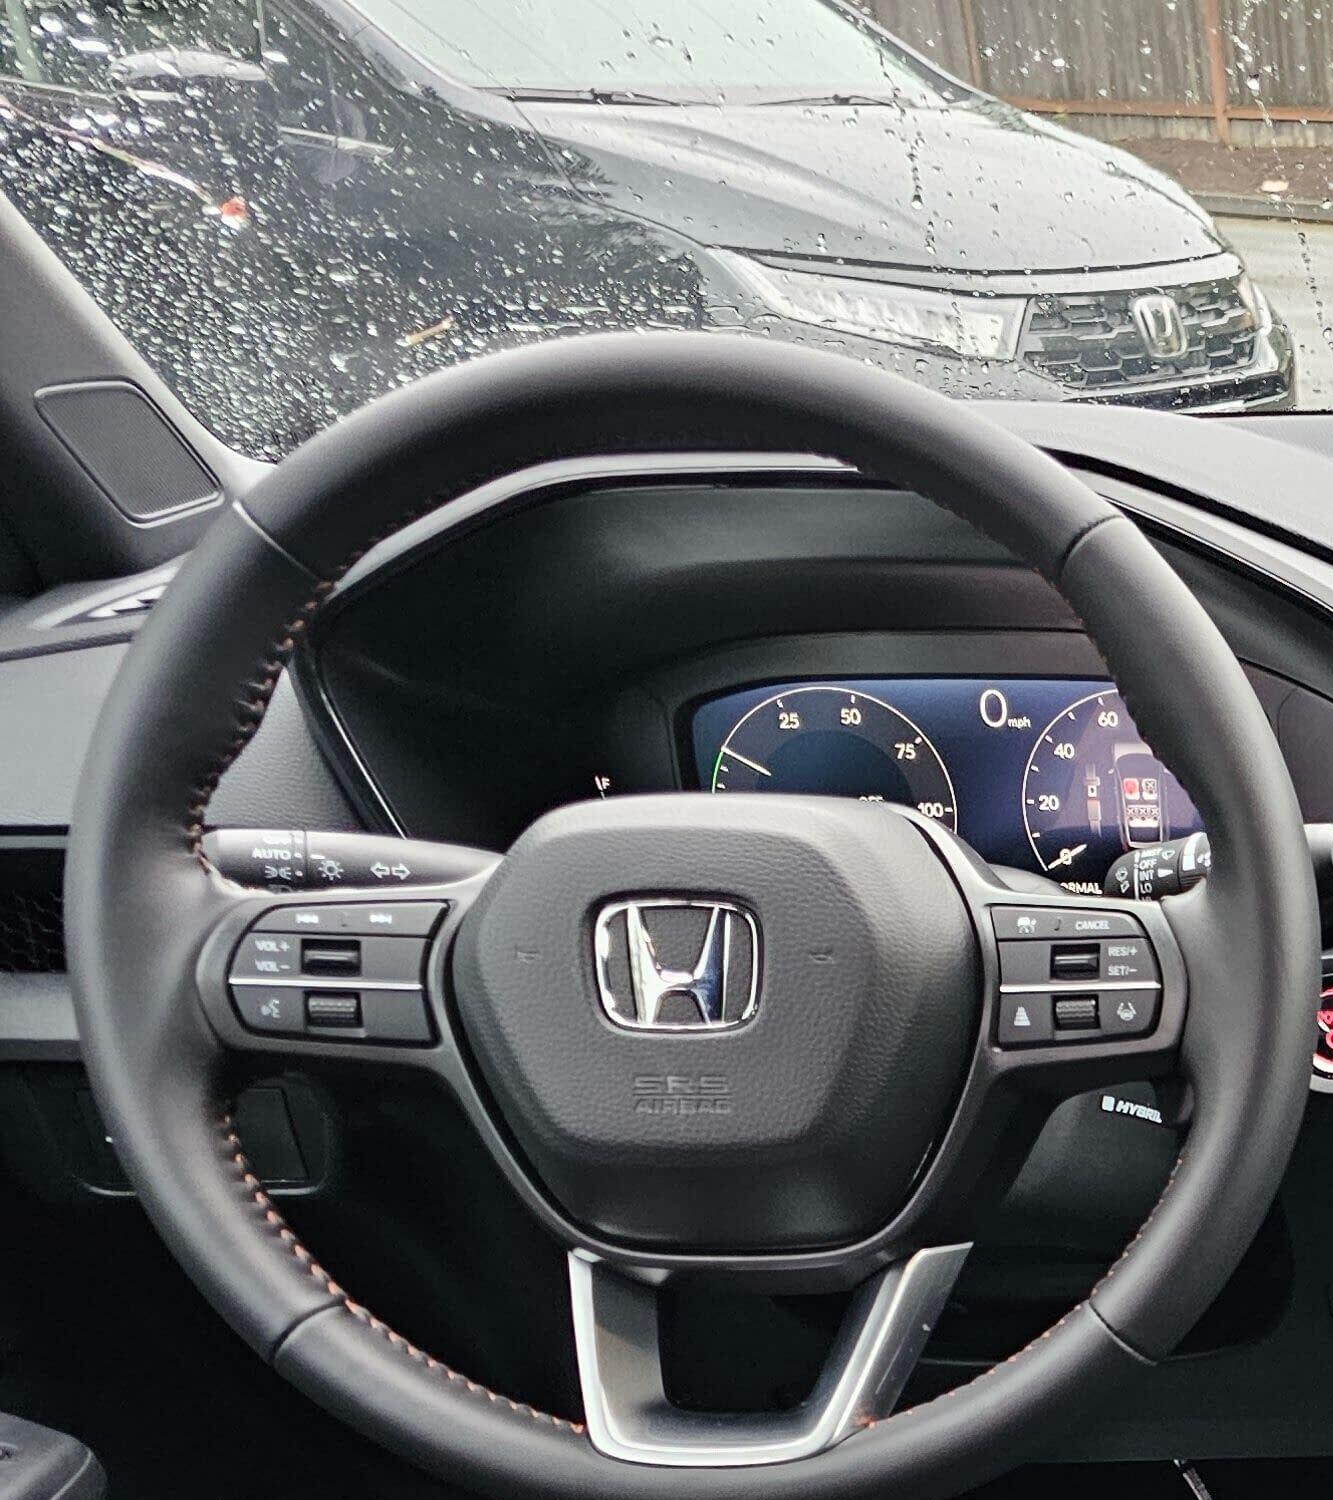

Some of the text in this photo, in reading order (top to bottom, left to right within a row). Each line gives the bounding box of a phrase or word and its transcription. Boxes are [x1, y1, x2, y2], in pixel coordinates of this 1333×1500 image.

[840, 706, 862, 726] 50
[981, 688, 1032, 729] 0 mph
[778, 712, 800, 730] 25
[1097, 710, 1119, 728] 60
[894, 742, 917, 760] 75
[1053, 742, 1075, 760] 40
[917, 802, 944, 818] 100
[1038, 794, 1060, 811] 20
[252, 848, 292, 860] AUTO
[1139, 858, 1158, 869] OFF
[1139, 869, 1155, 881] INT
[1140, 883, 1153, 894] LO
[1075, 919, 1110, 931] CANCEL
